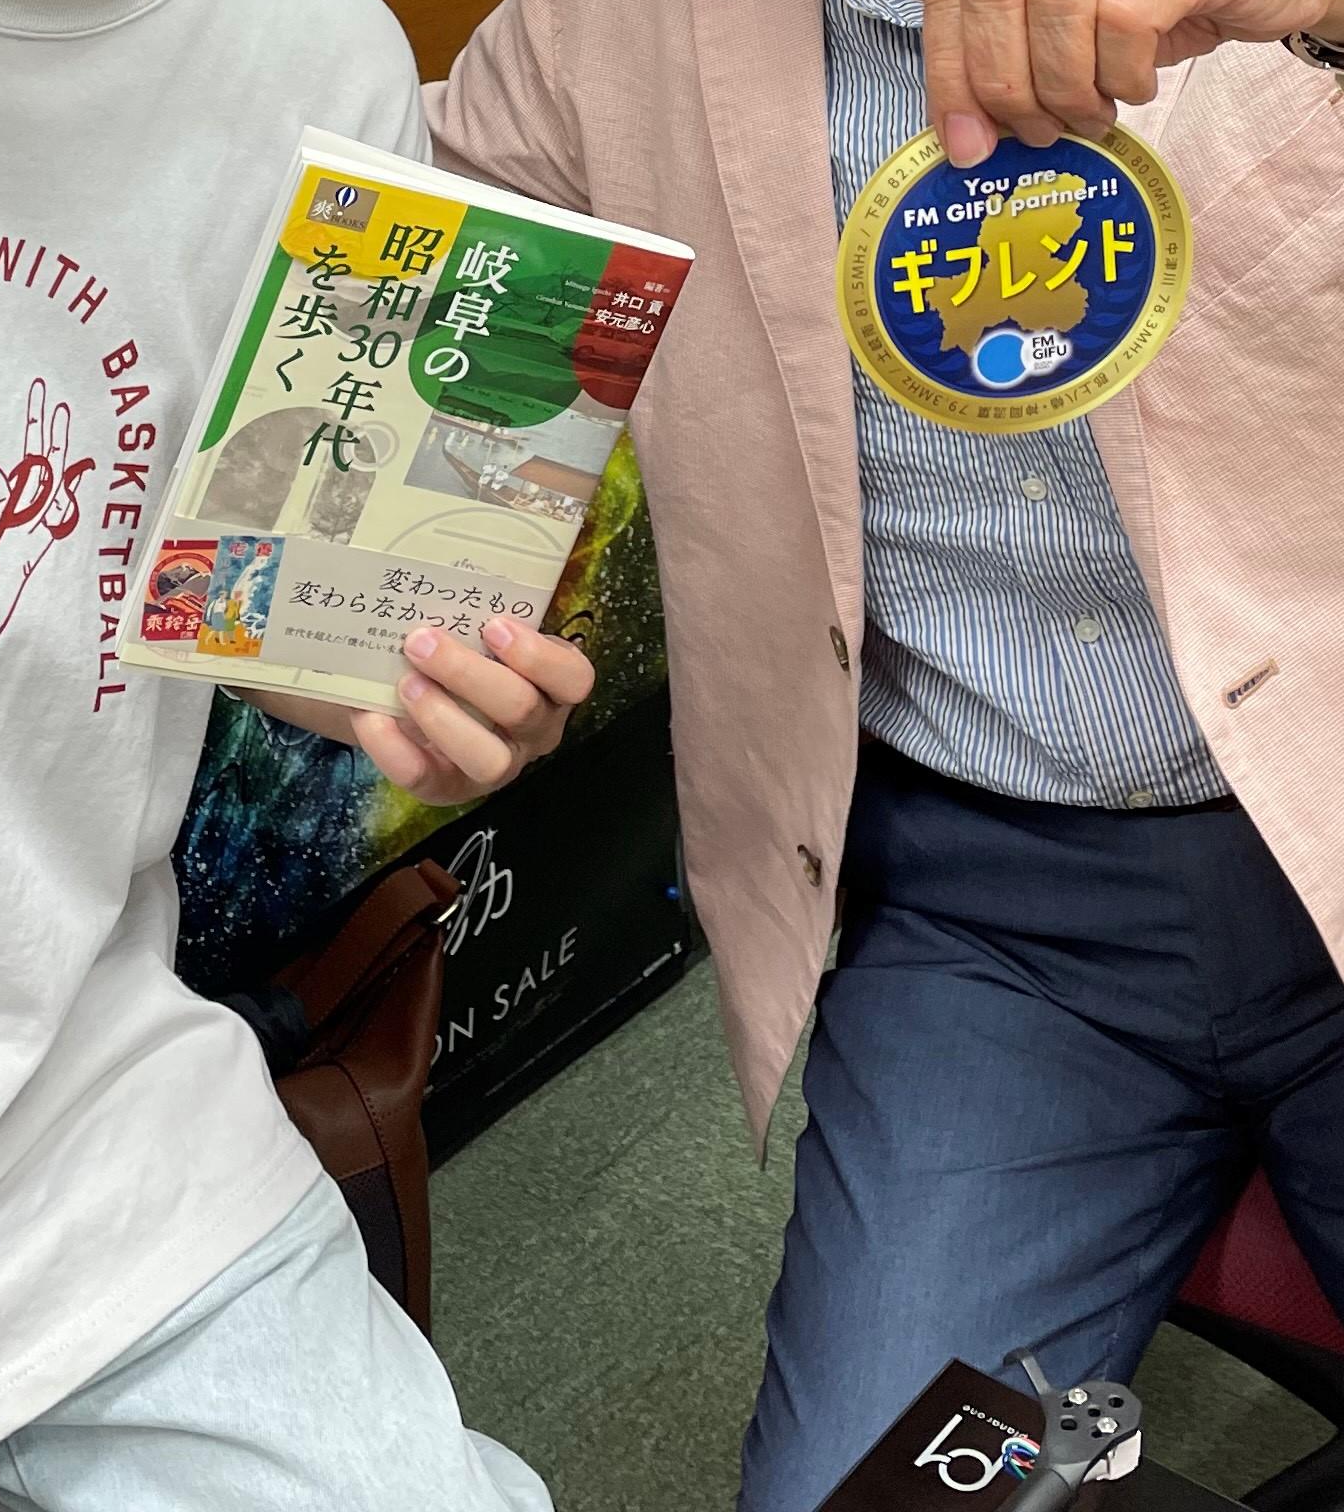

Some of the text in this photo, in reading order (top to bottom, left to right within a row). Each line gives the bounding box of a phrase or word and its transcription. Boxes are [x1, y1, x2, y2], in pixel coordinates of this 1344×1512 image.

[882, 139, 946, 191] 82.1MH
[963, 169, 1057, 196] You are
[903, 184, 1096, 228] FM GIFU partner
[890, 219, 1136, 314] ギフレンド
[274, 243, 354, 393] を歩く
[423, 239, 522, 384] 岐阜の
[611, 291, 645, 311] 井口
[302, 222, 447, 473] 昭和30年代
[1031, 335, 1055, 348] FM
[1032, 344, 1068, 361] GIFU
[92, 338, 157, 714] BASKETBALL
[379, 567, 535, 620] 変わったもの
[492, 925, 579, 1023] SALE
